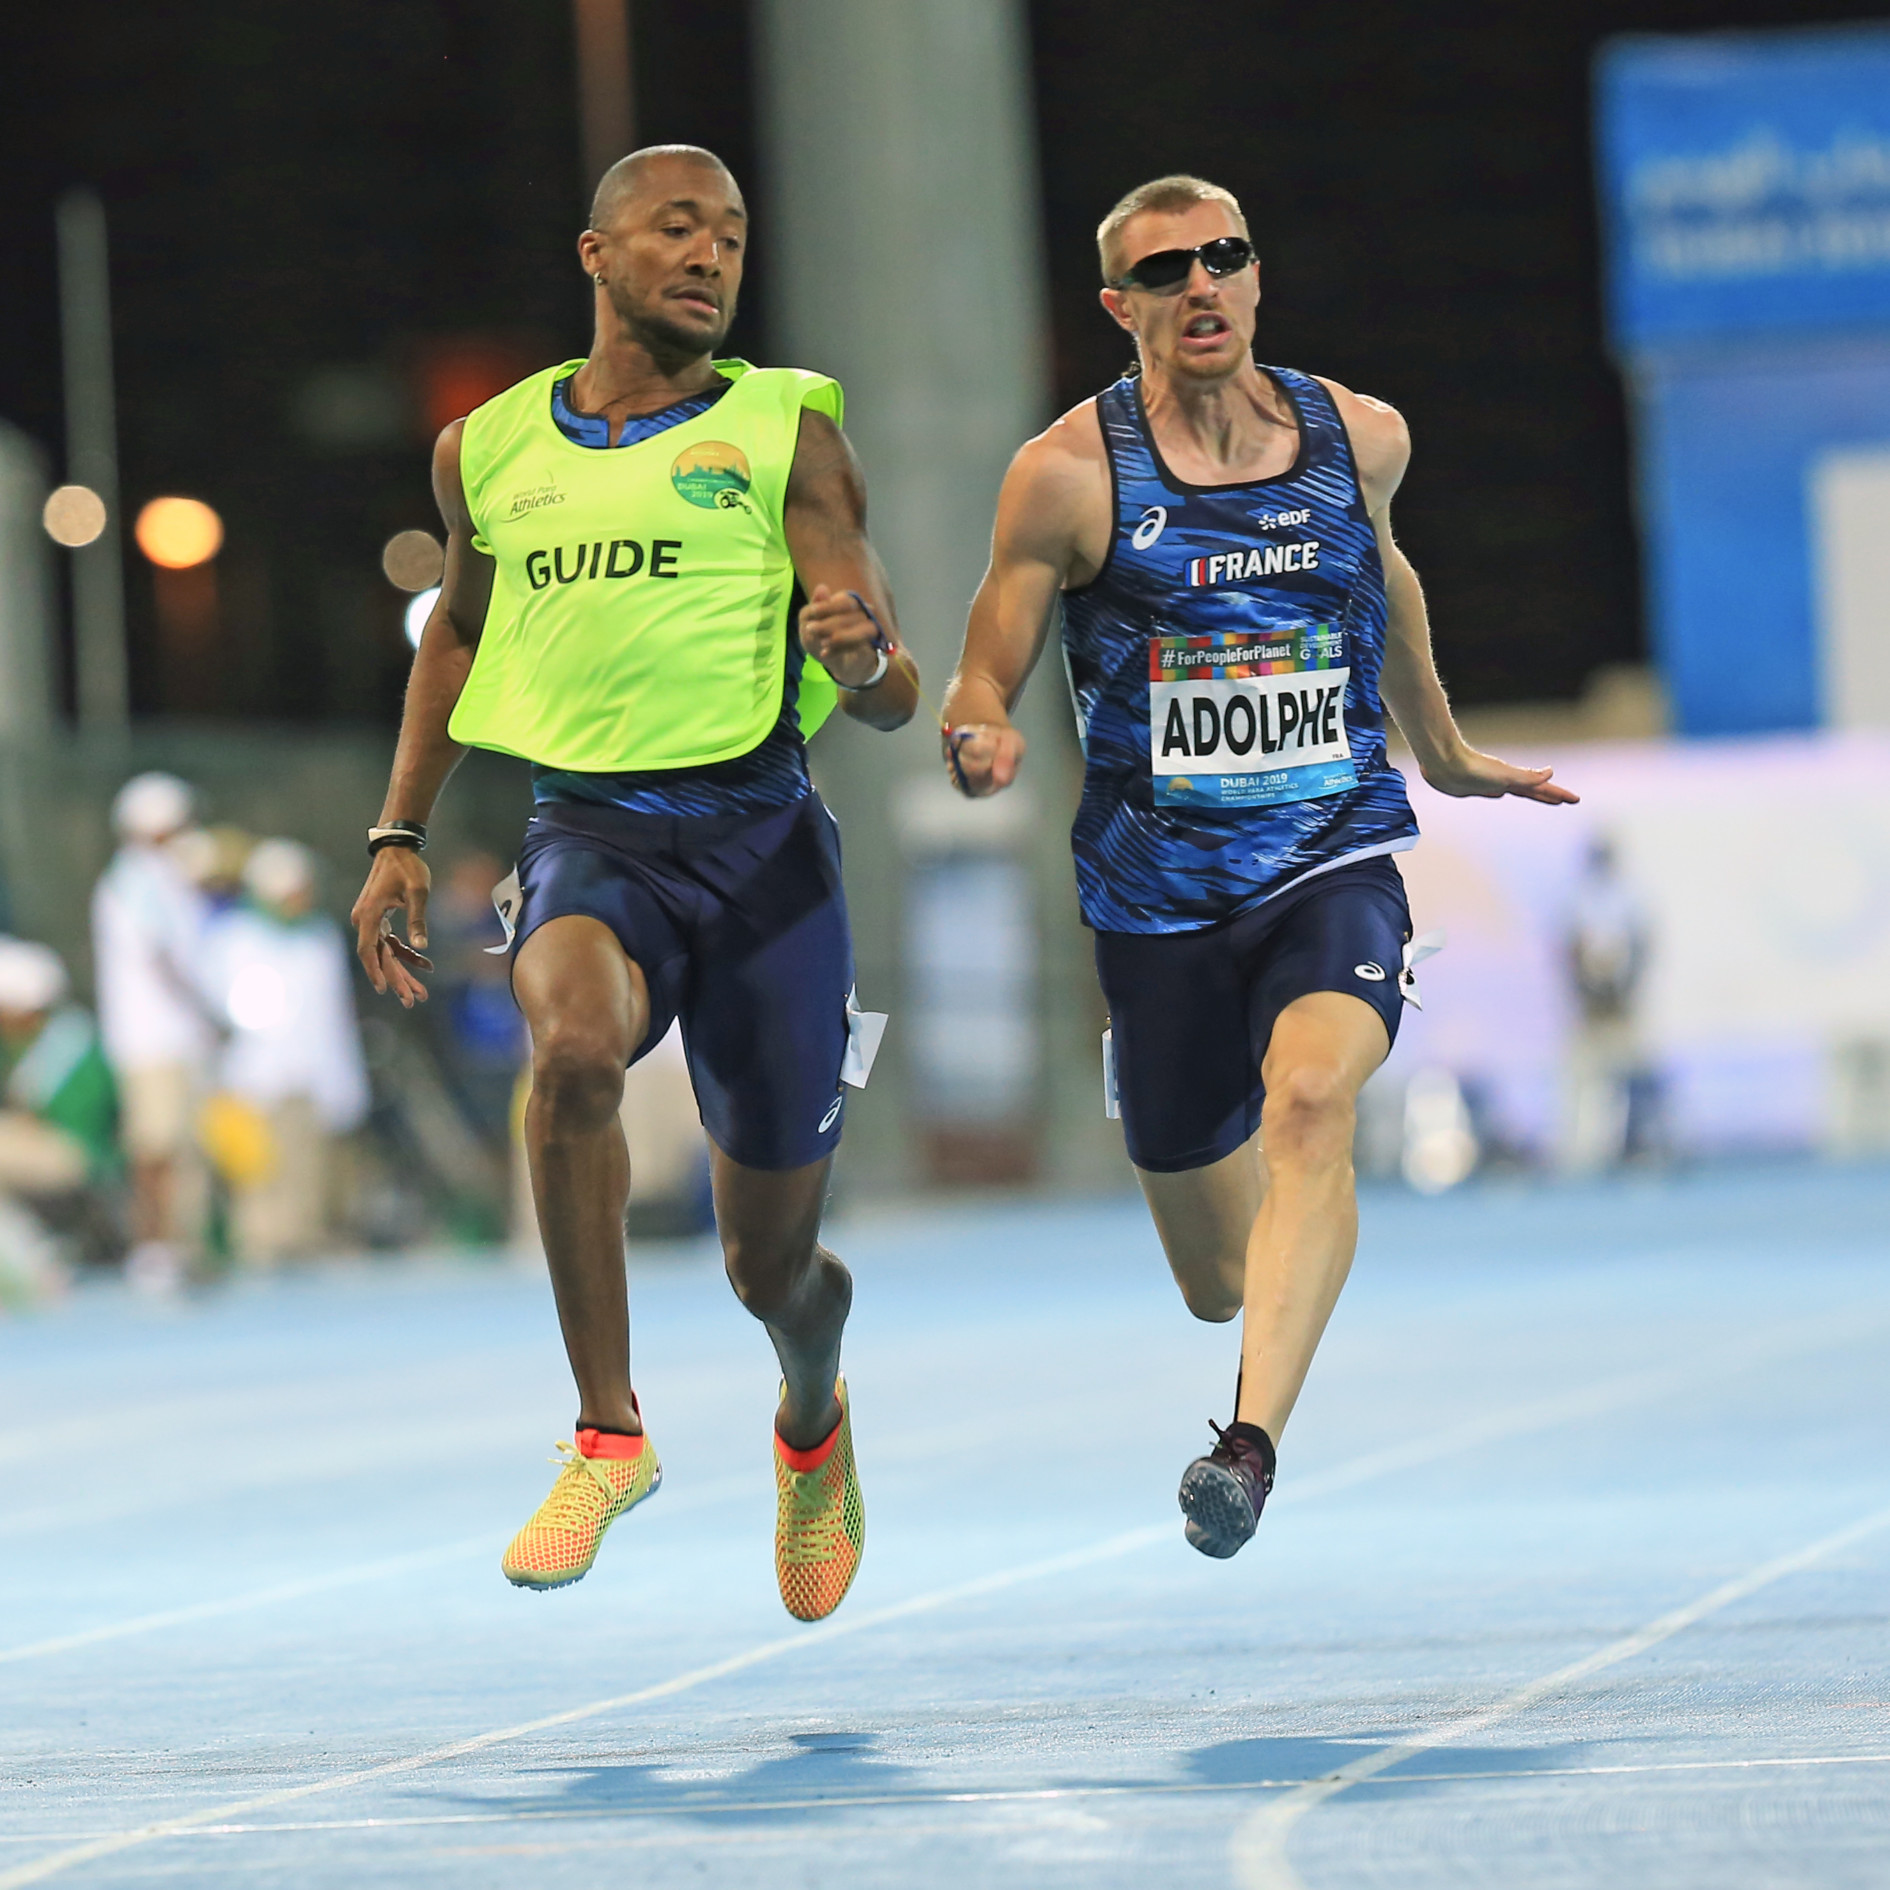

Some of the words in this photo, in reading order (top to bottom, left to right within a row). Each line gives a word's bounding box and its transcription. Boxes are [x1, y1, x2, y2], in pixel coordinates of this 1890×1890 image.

[509, 491, 567, 516] Athletics
[526, 539, 682, 590] GUIDE
[1208, 541, 1320, 584] FRANCE
[1161, 643, 1291, 668] #ForPeopleForPlanet
[1161, 685, 1341, 757] ADOLPHE
[1220, 777, 1260, 788] DUBAI
[1262, 773, 1288, 786] 2019
